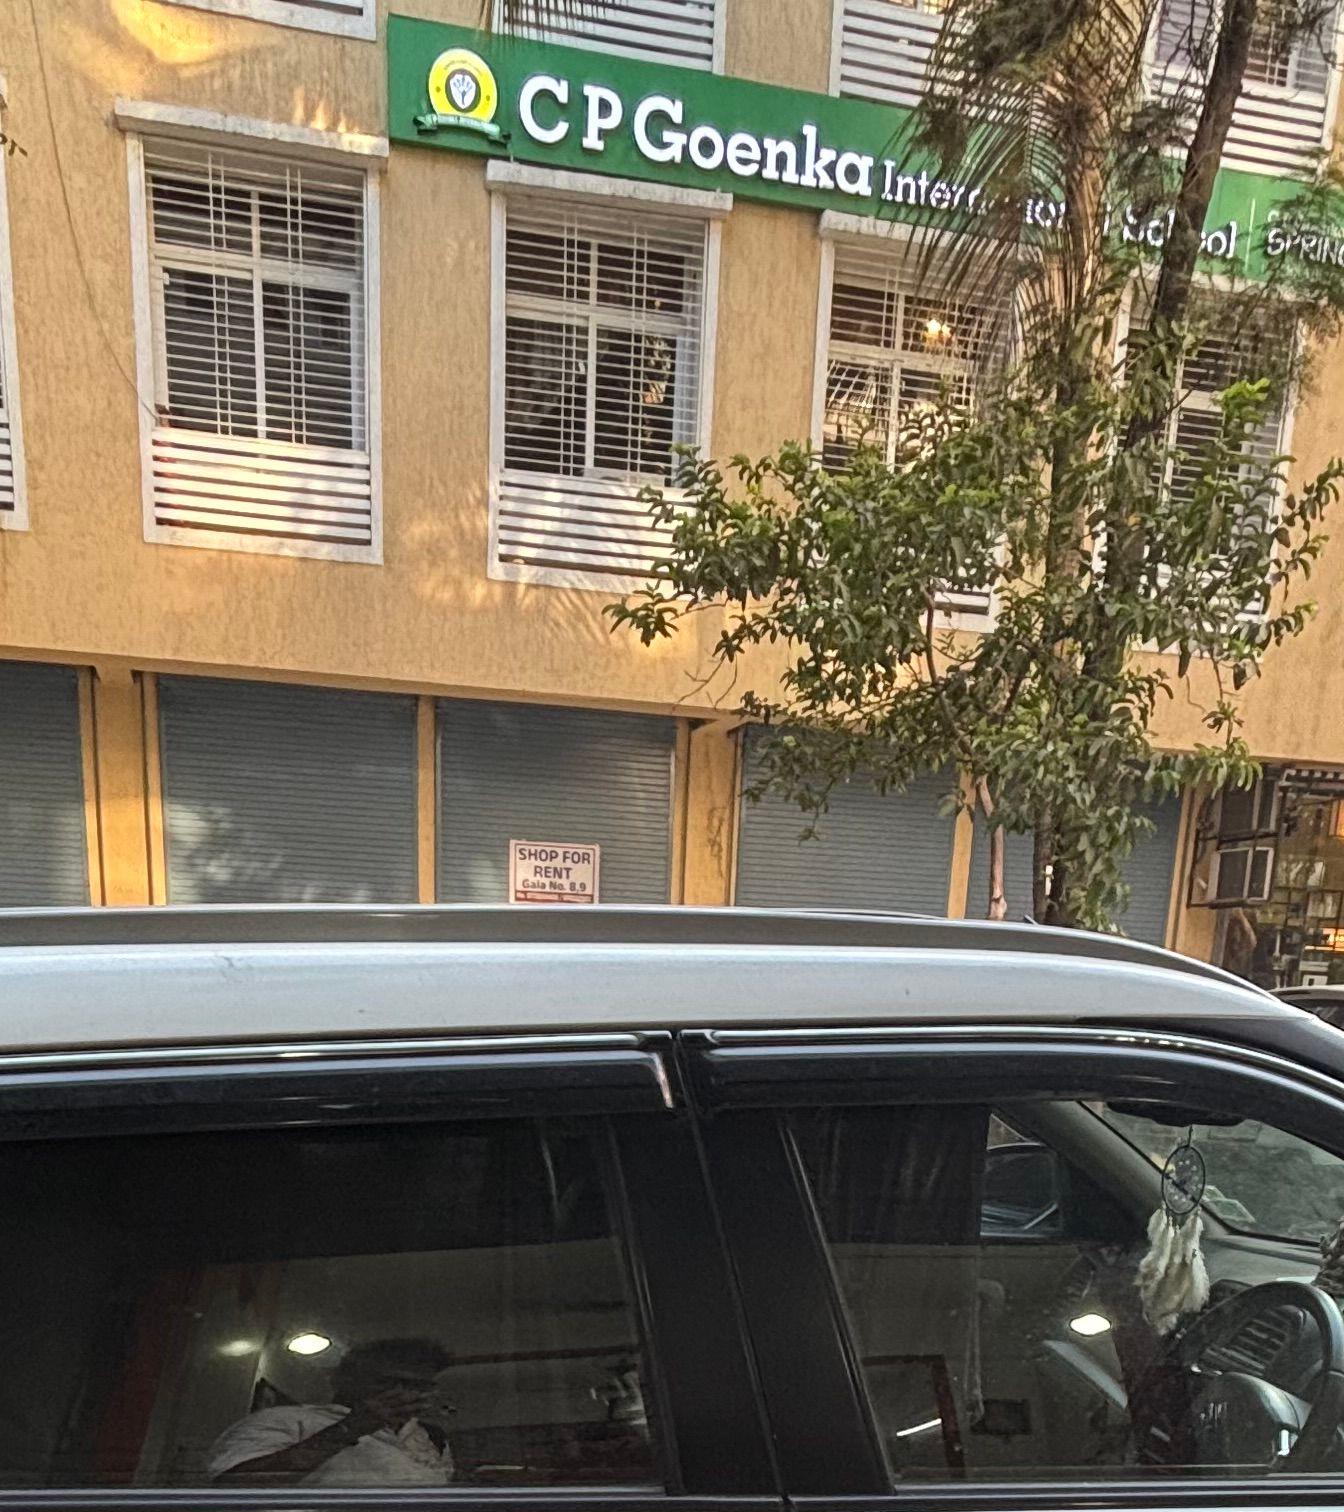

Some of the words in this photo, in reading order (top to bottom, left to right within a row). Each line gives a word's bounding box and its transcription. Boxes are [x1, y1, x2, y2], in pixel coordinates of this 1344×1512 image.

[518, 74, 569, 145] C
[582, 84, 623, 152] P
[632, 96, 873, 197] Goenka
[518, 847, 559, 863] SHOP
[562, 850, 591, 865] FOR
[534, 865, 573, 880] RENT
[522, 879, 546, 890] Gala
[549, 881, 567, 892] No.
